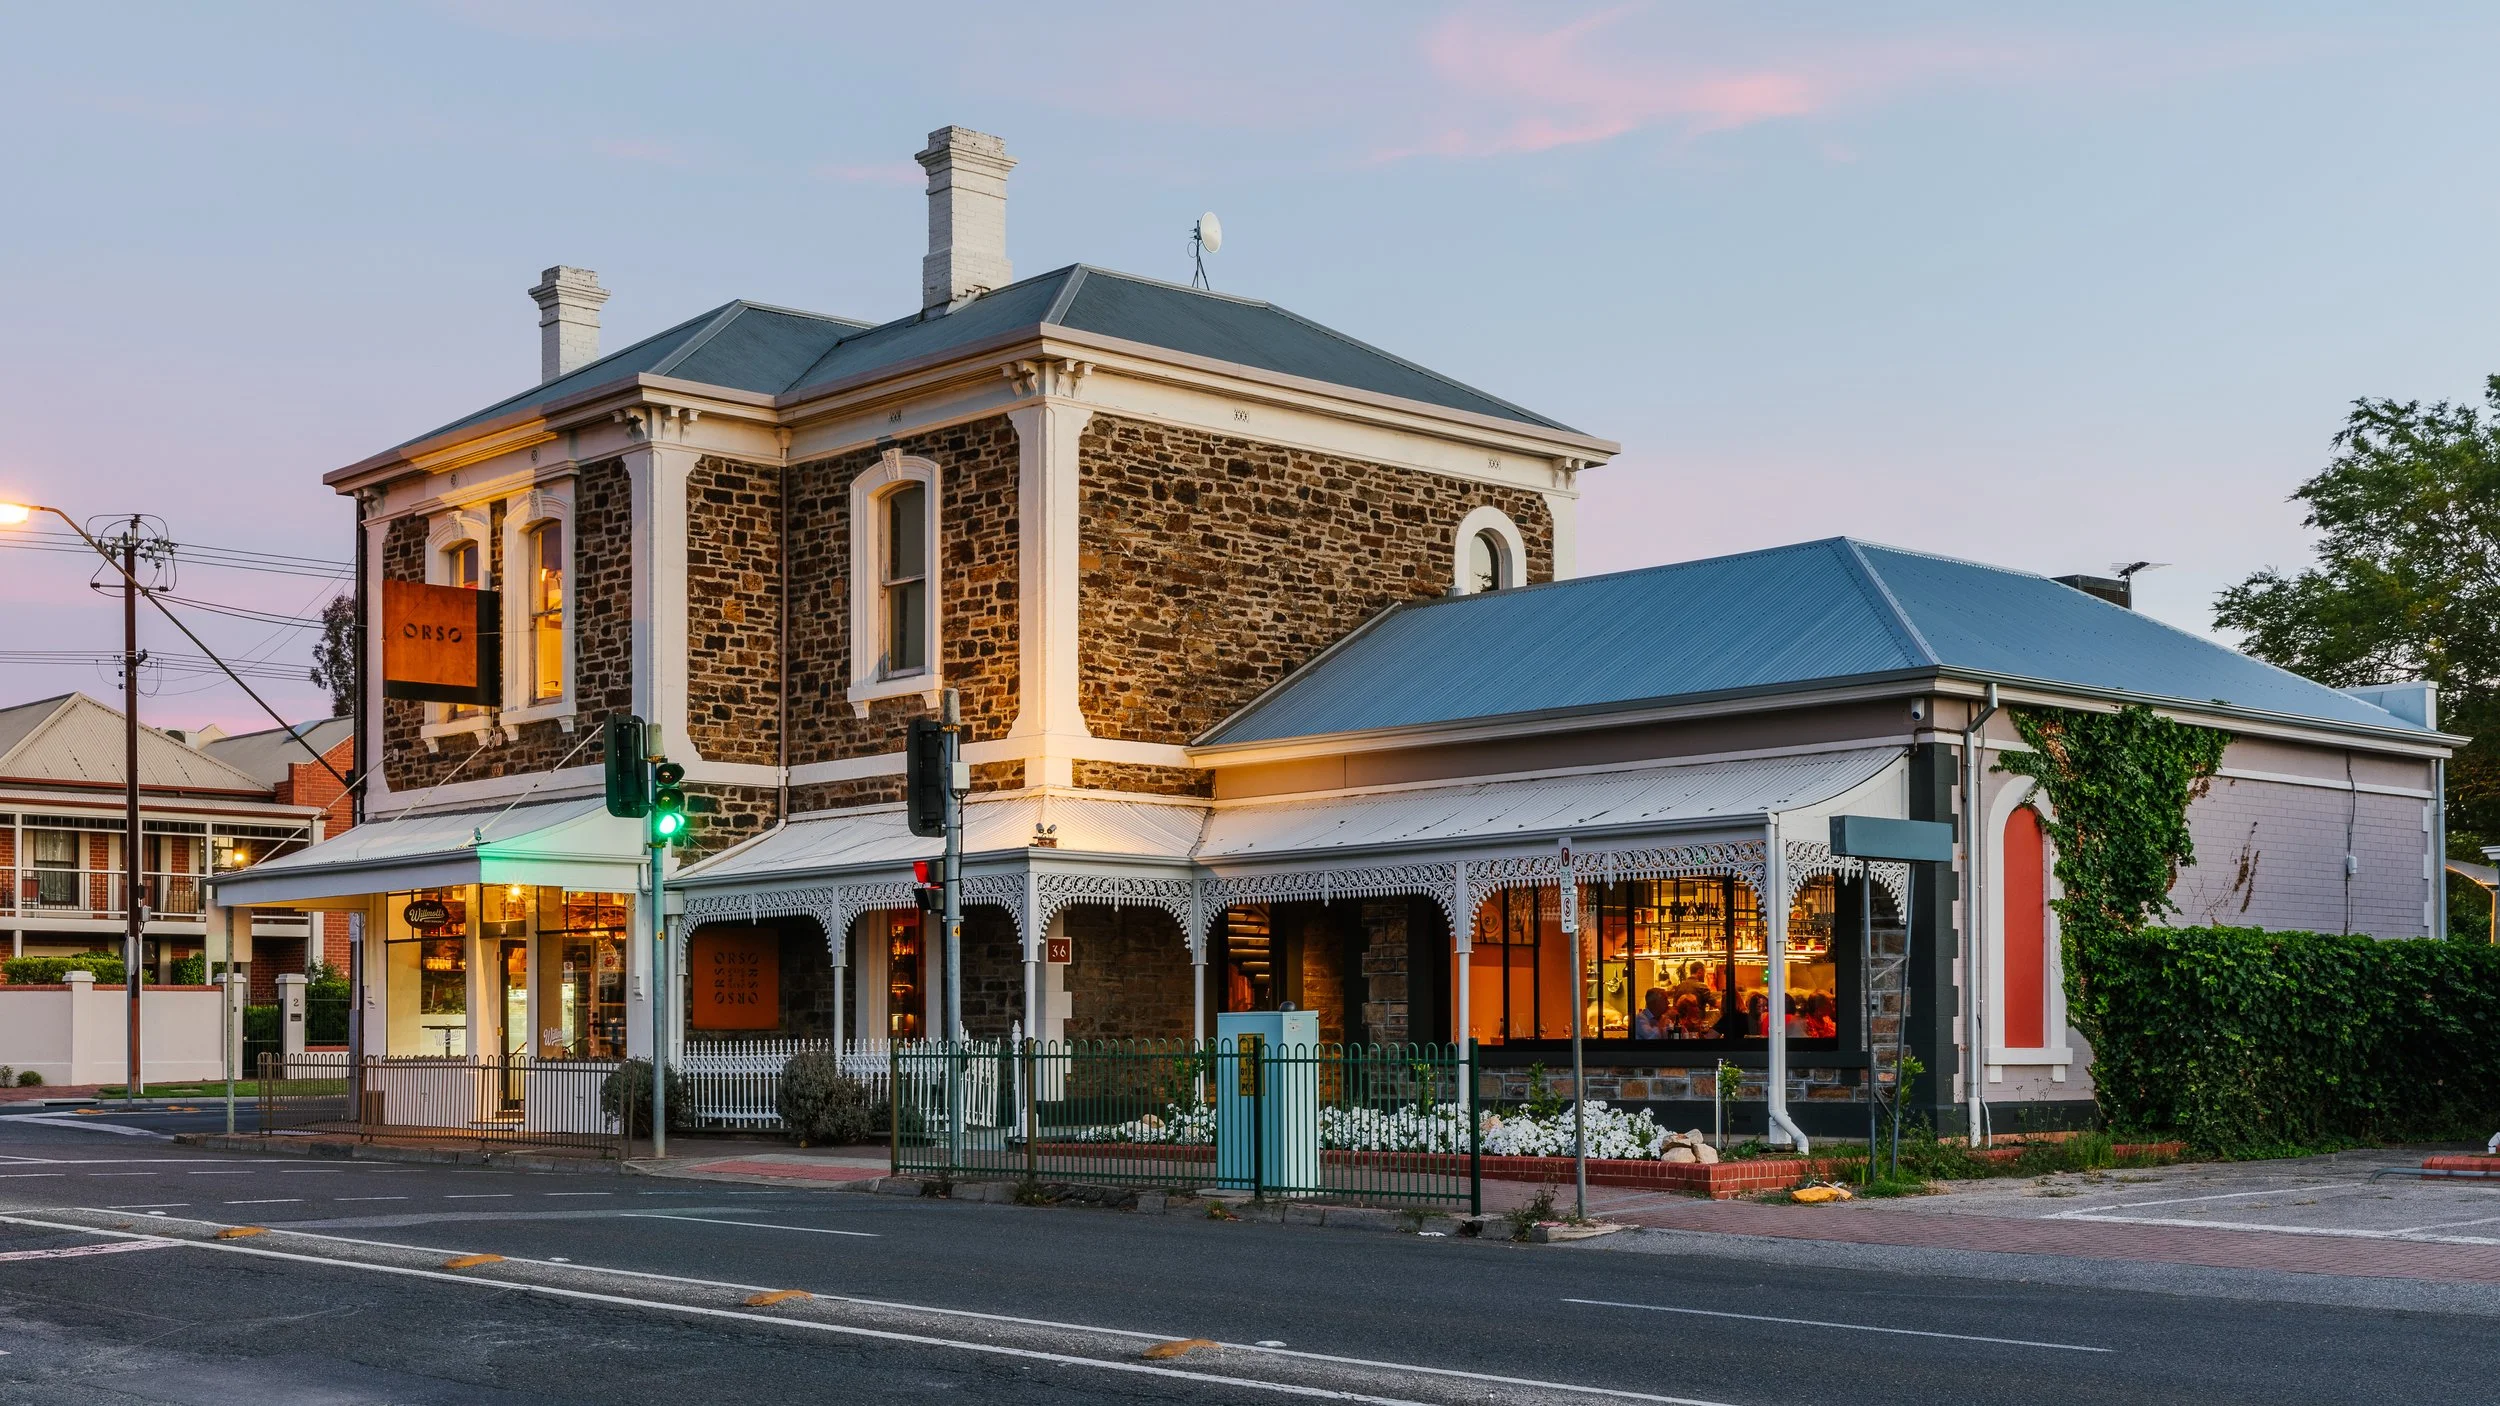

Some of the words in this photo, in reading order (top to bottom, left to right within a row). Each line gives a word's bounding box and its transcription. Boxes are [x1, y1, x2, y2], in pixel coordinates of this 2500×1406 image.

[403, 623, 463, 643] ORSO
[714, 951, 759, 965] ORSO
[1052, 945, 1067, 958] 36
[293, 998, 299, 1006] 2
